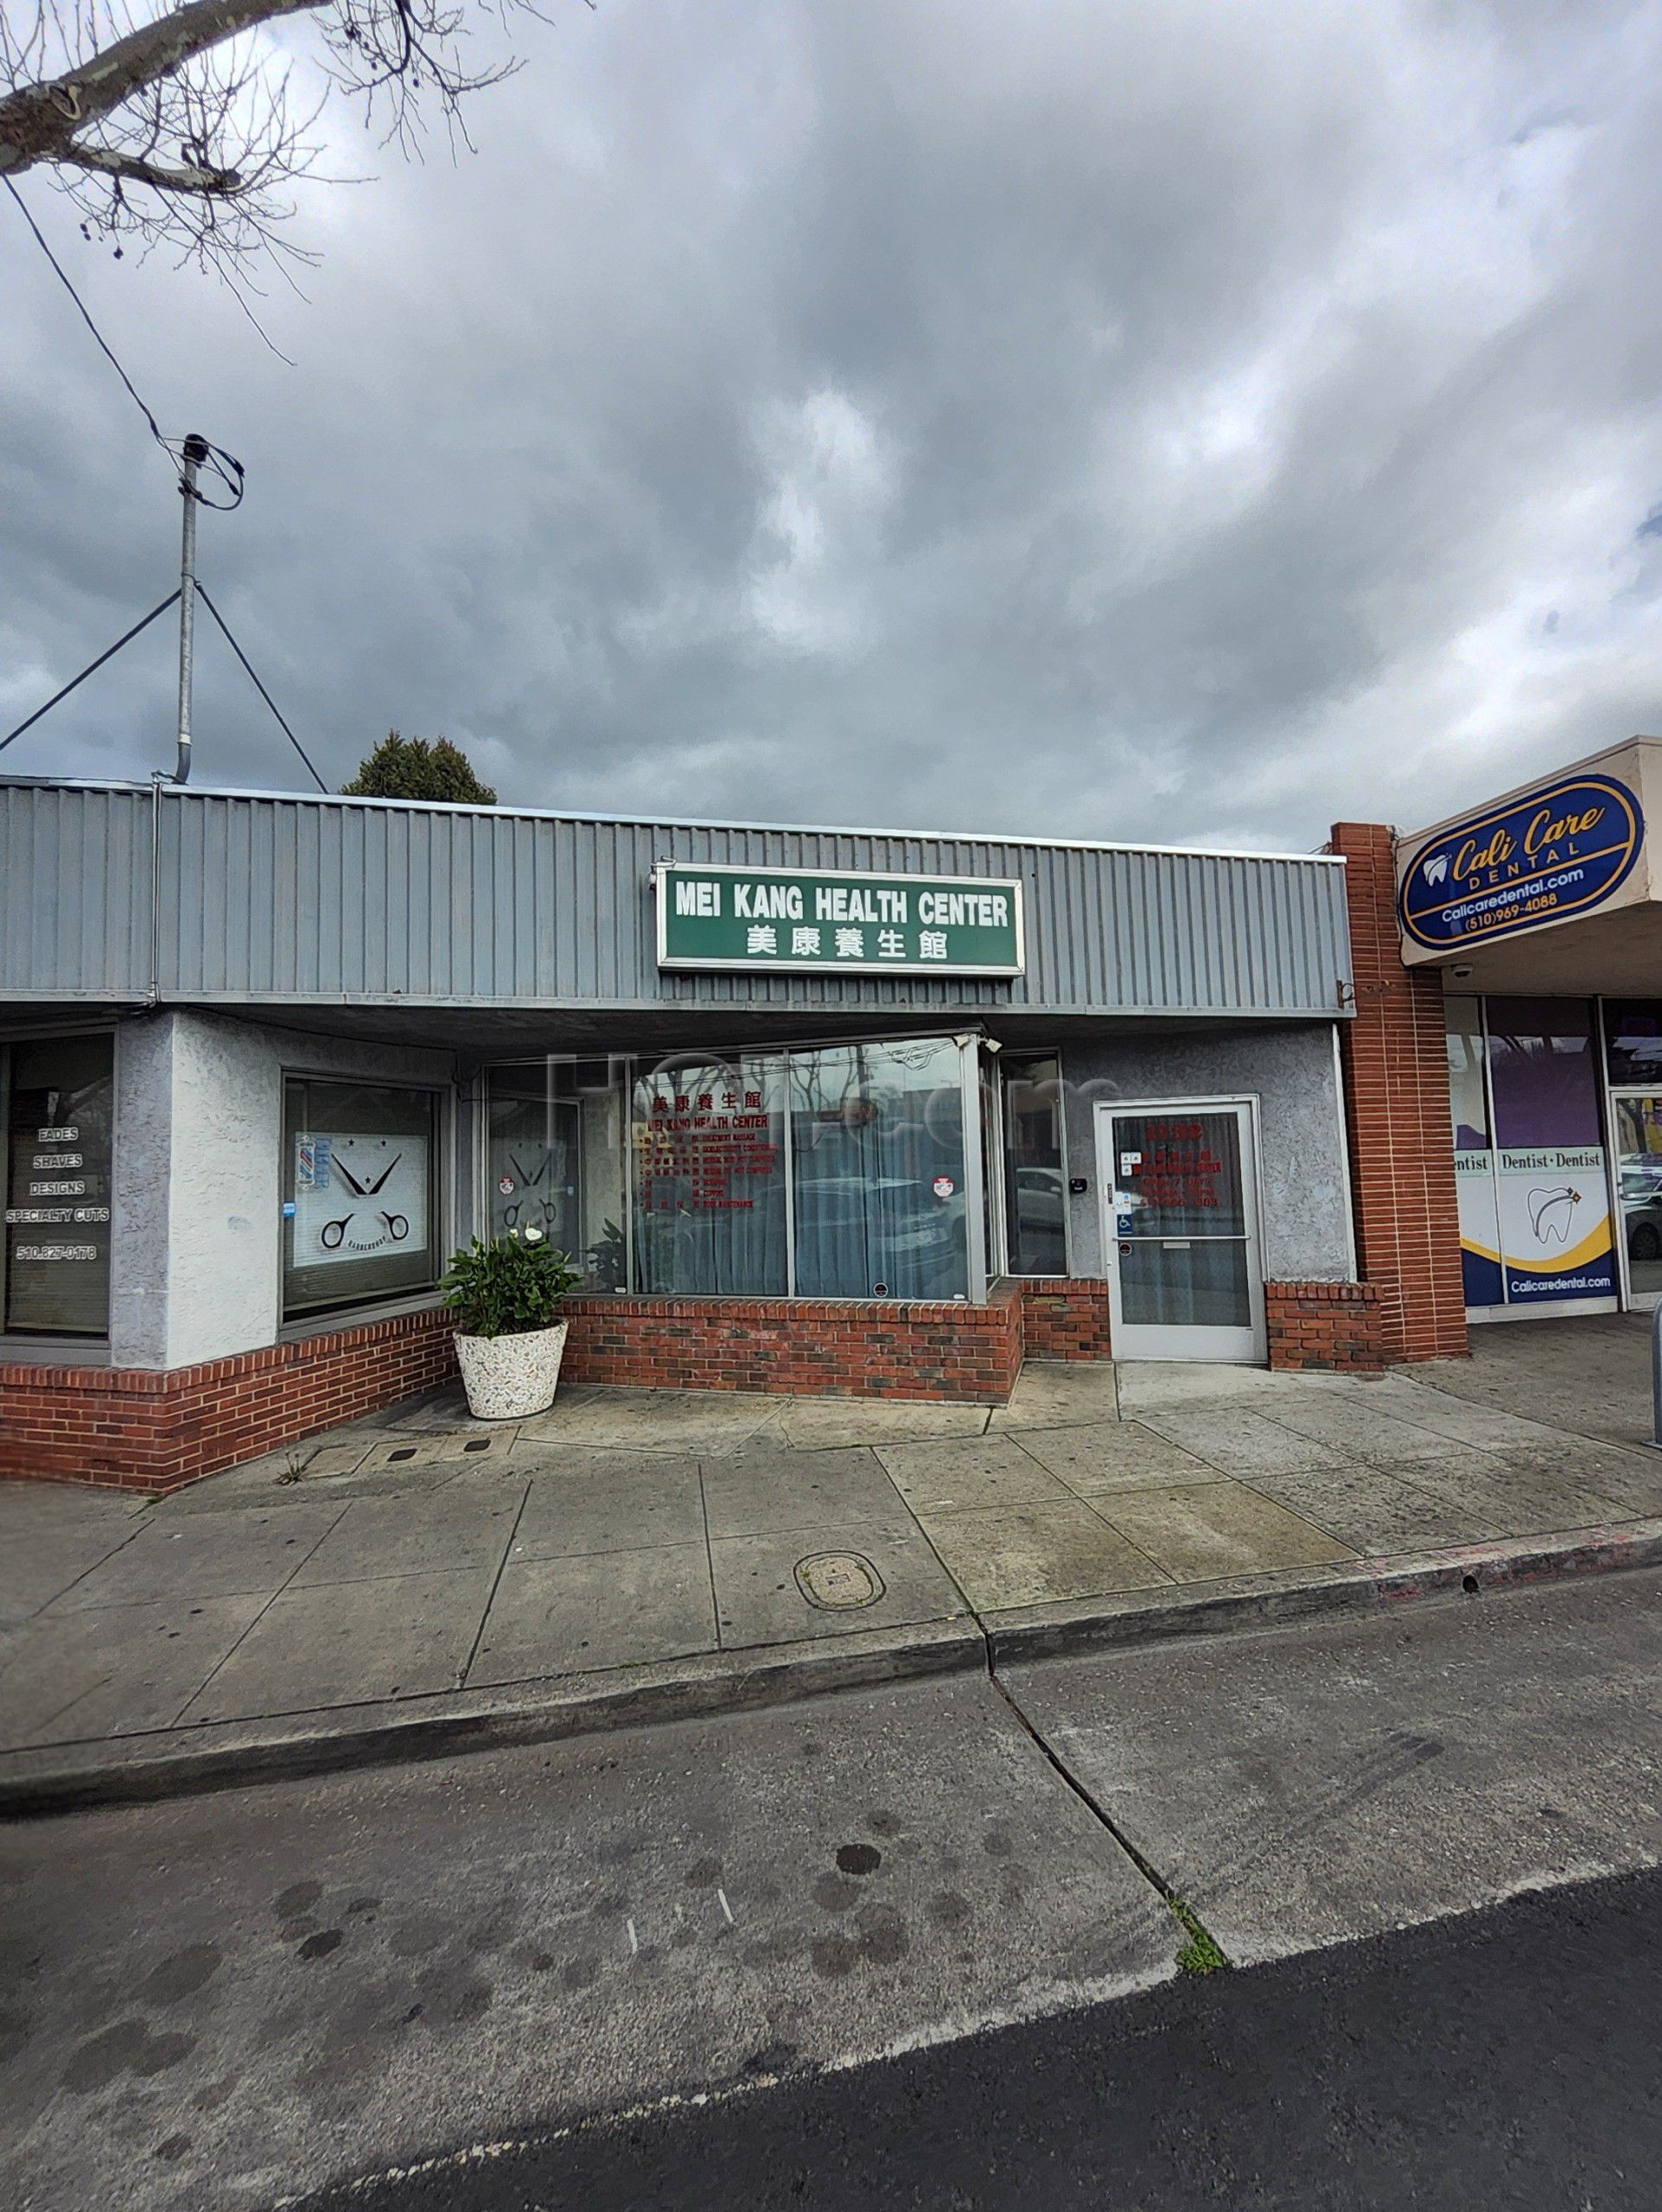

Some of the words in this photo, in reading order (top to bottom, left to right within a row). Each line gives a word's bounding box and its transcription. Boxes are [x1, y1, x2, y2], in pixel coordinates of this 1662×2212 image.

[1453, 829, 1517, 881] Cali
[1525, 807, 1605, 855] Care
[1470, 842, 1579, 890] DENTAL
[676, 880, 720, 917] MEI
[735, 883, 803, 919] KANG
[816, 887, 907, 924] HEALTH
[919, 891, 1009, 927] CENTER
[1442, 868, 1584, 922] Calicaredental.com
[1465, 893, 1557, 931] (510)969-4088
[747, 925, 948, 959] 美康養生館
[652, 1090, 762, 1113] 美康養生館
[732, 1114, 768, 1128] CENTER
[33, 1154, 83, 1169] SHAVES
[1502, 1154, 1549, 1169] Dentist
[1556, 1152, 1601, 1167] Dentist
[29, 1180, 85, 1196] DESIGNS
[5, 1208, 72, 1224] SPECIALTY
[74, 1207, 110, 1223] CUTS
[1511, 1277, 1611, 1293] Calicaredental.com
